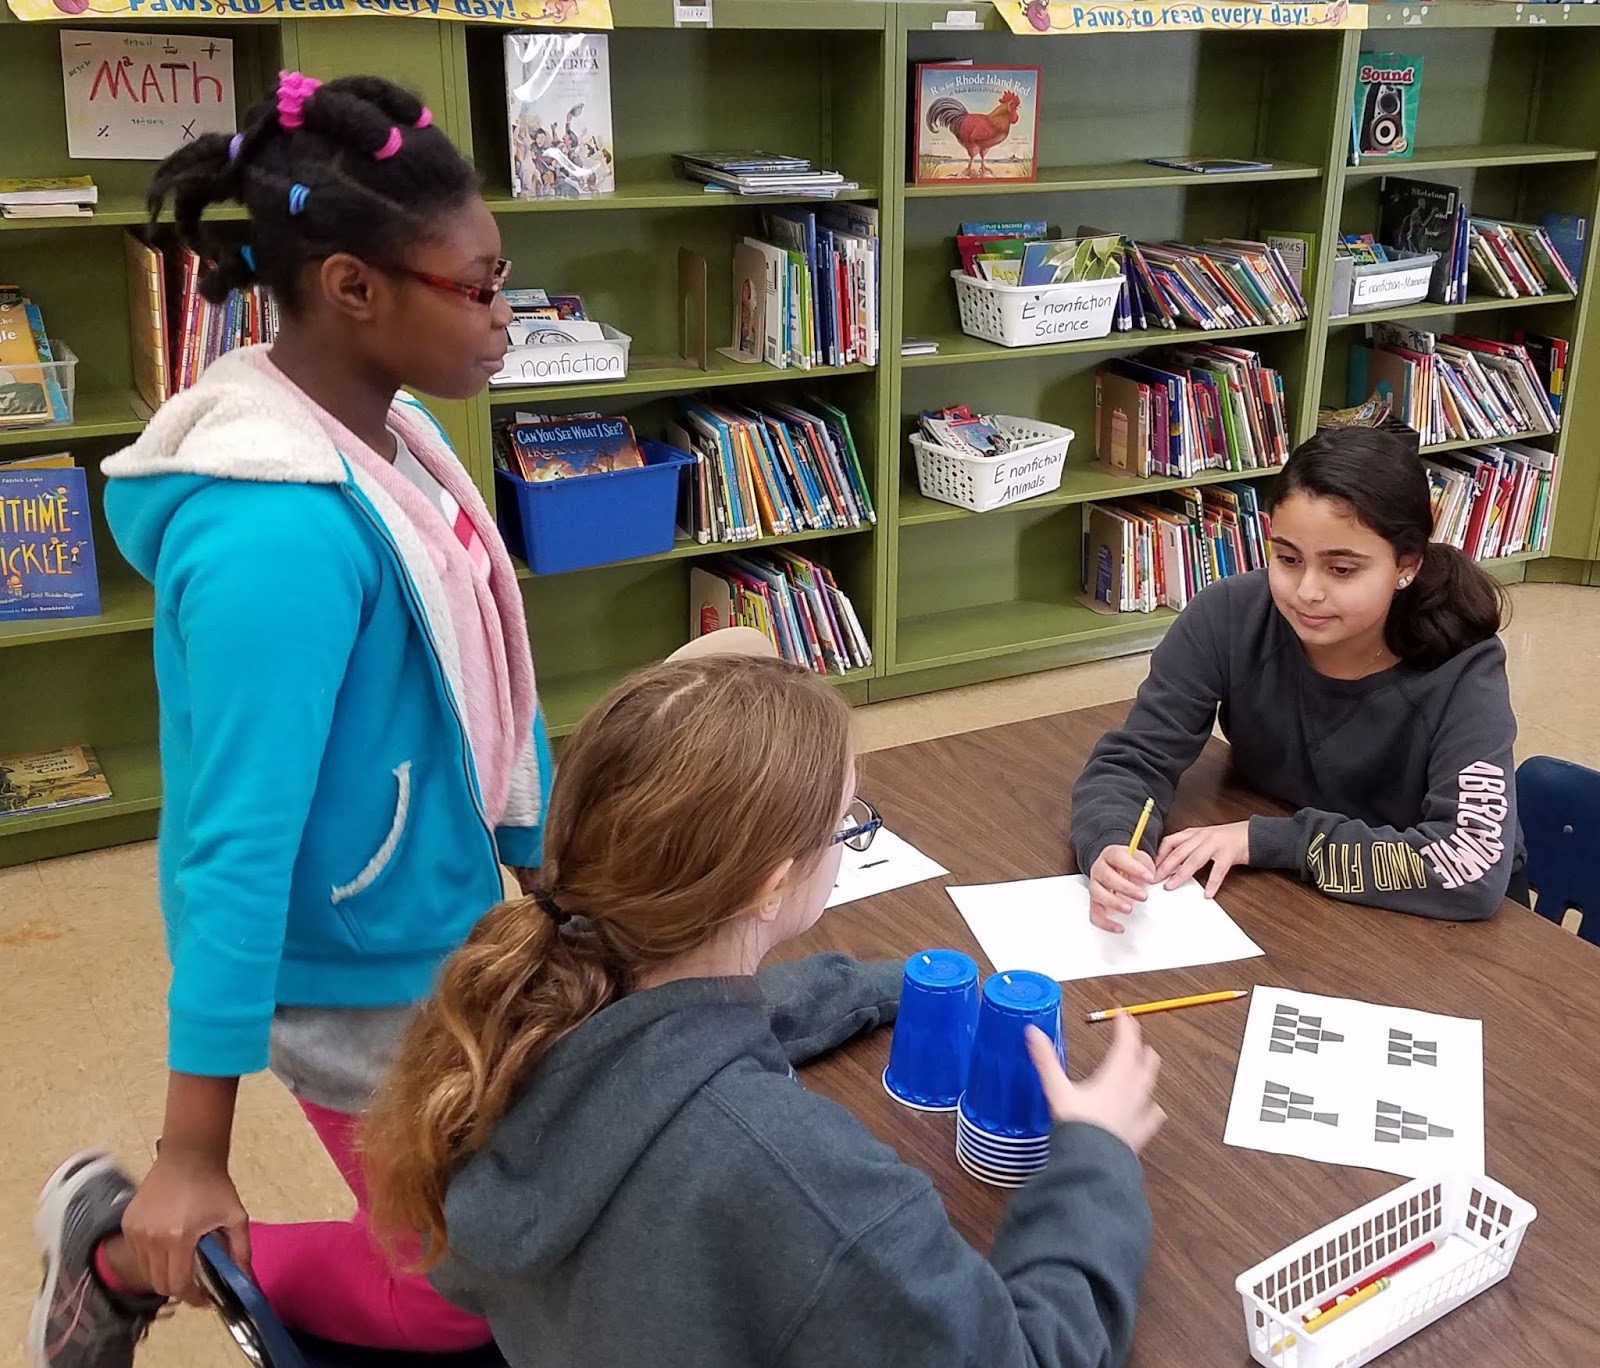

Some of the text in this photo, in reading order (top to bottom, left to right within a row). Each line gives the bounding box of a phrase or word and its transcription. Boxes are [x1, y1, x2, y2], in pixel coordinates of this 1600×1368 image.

[457, 0, 518, 19] day!
[1073, 4, 1311, 27] Paws to read every day!
[930, 86, 938, 96] R
[955, 73, 985, 86] Rhode
[986, 74, 1013, 89] Island
[1014, 81, 1031, 96] Red
[1360, 67, 1414, 82] Sound
[1358, 280, 1366, 296] E
[1022, 295, 1112, 319] E nonfiction
[1035, 320, 1089, 337] Science
[520, 352, 620, 378] nonfiction
[597, 424, 603, 438] I
[994, 452, 1062, 485] E nonfiction
[998, 474, 1045, 502] Animals
[1371, 841, 1428, 891] AND
